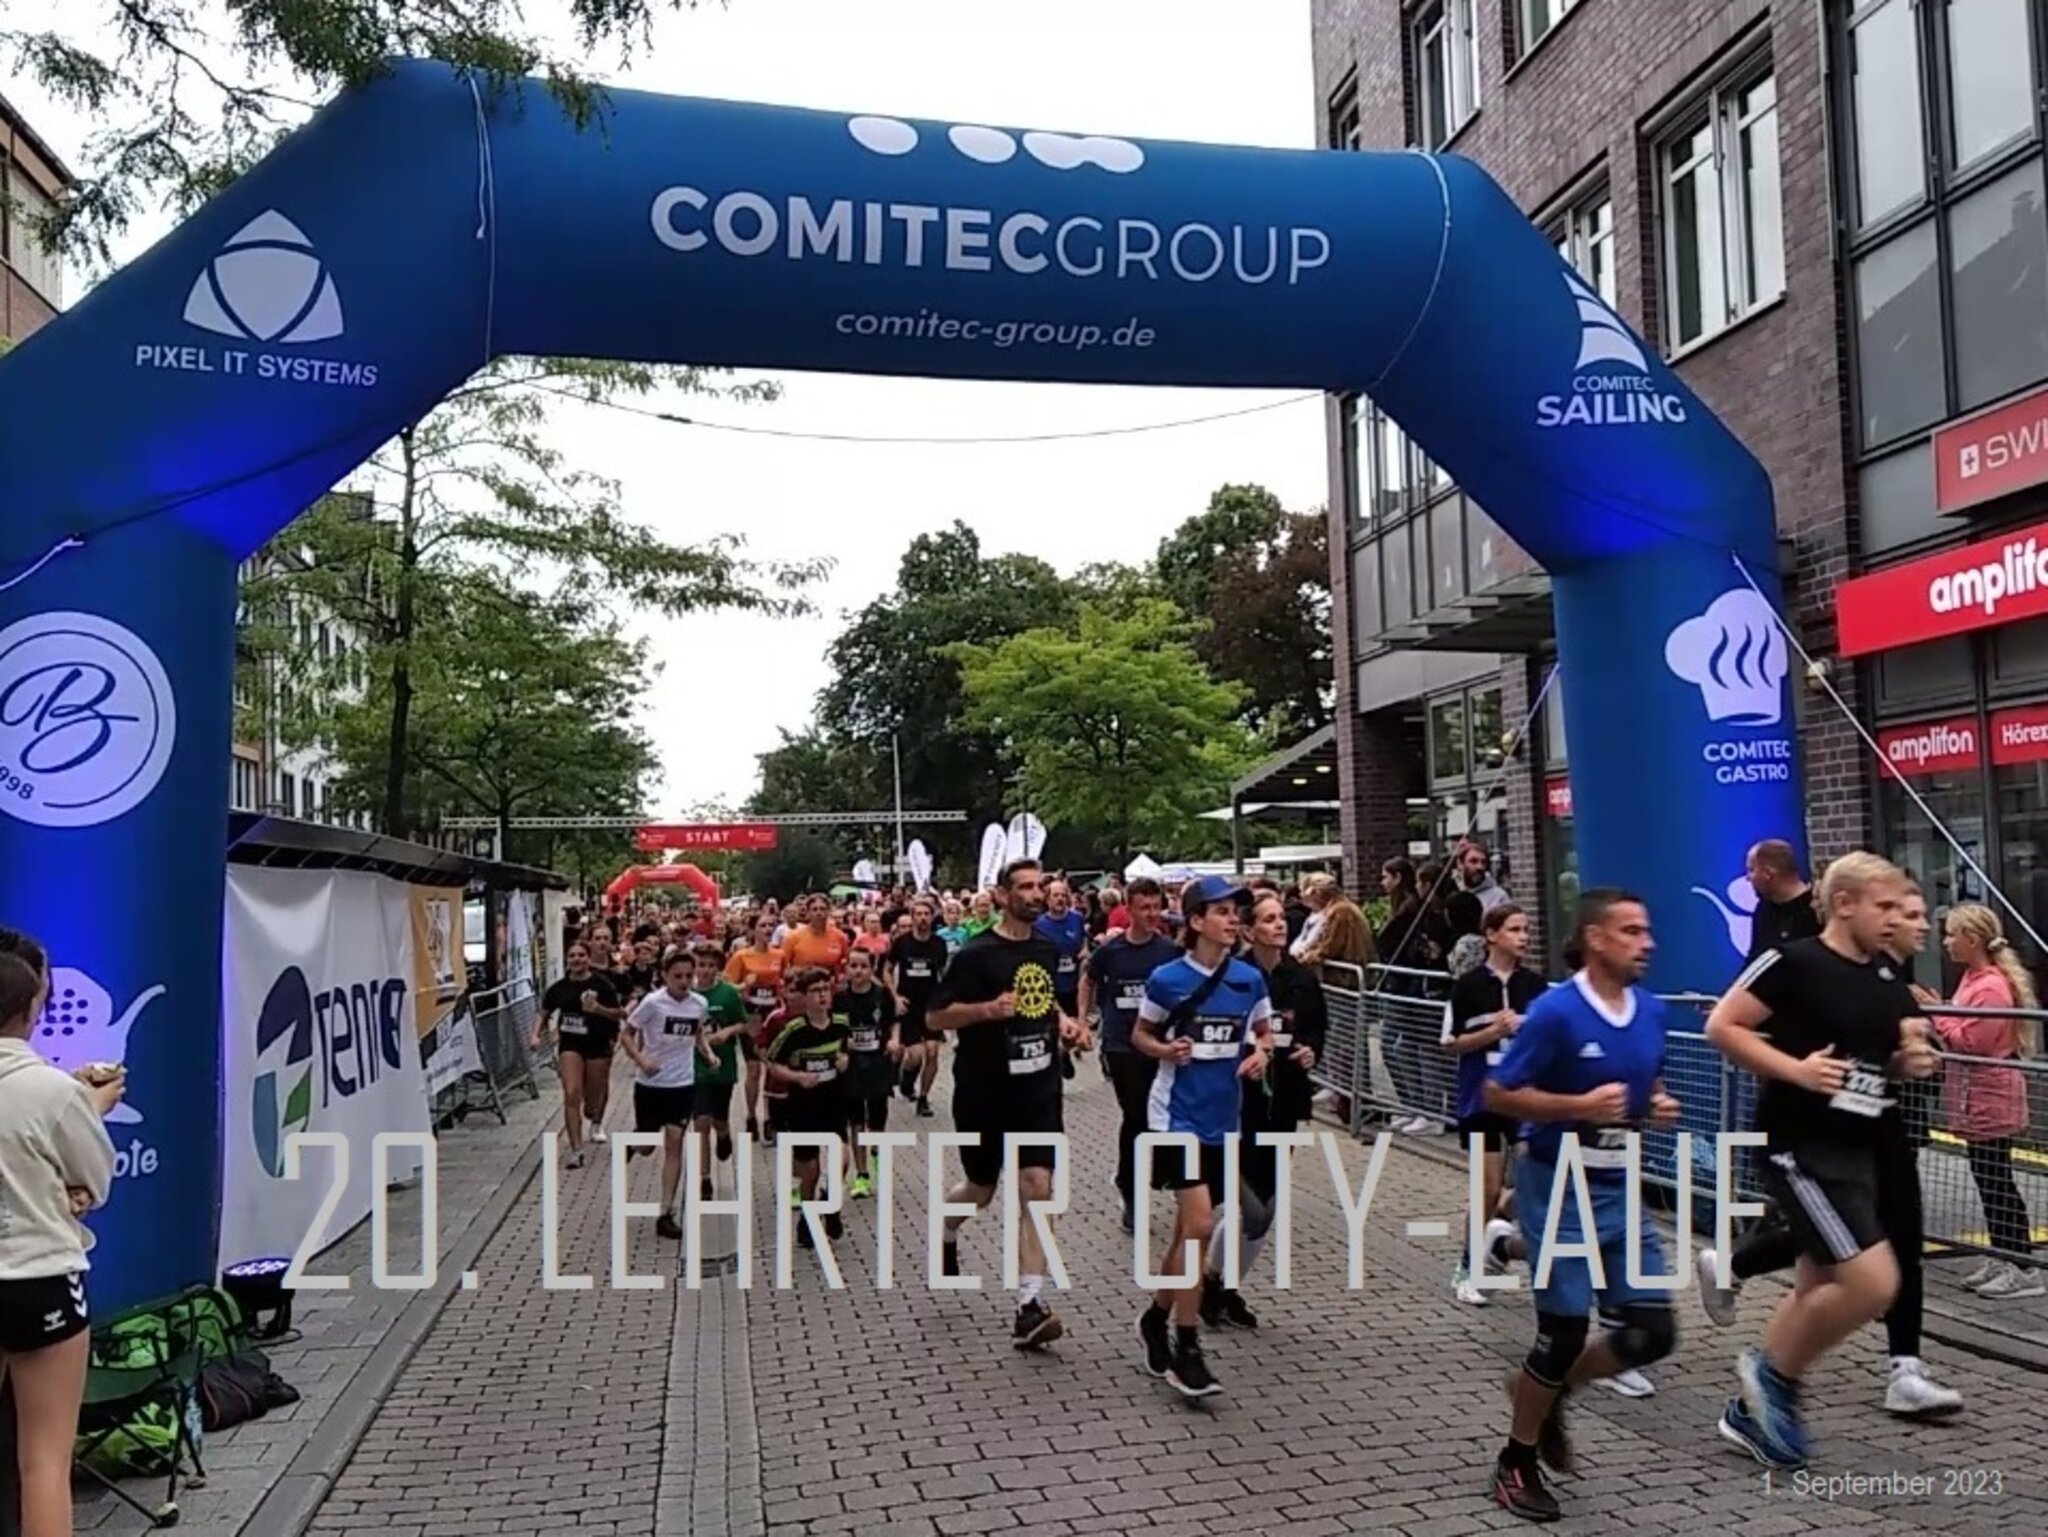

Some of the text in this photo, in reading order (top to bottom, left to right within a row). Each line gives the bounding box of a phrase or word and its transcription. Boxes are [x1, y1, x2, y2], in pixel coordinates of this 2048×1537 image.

[650, 185, 1331, 285] COMITECGROUP
[835, 307, 1156, 349] comitec-group.de
[136, 345, 378, 386] PIXEL IT SYSTEMS
[1572, 375, 1655, 393] COMITEC
[1536, 393, 1687, 427] SAILING
[1703, 739, 1791, 762] COMITEC
[1888, 724, 1974, 766] amplifon
[1715, 763, 1789, 784] GASTRO
[686, 831, 730, 843] START
[1203, 1024, 1234, 1042] 947
